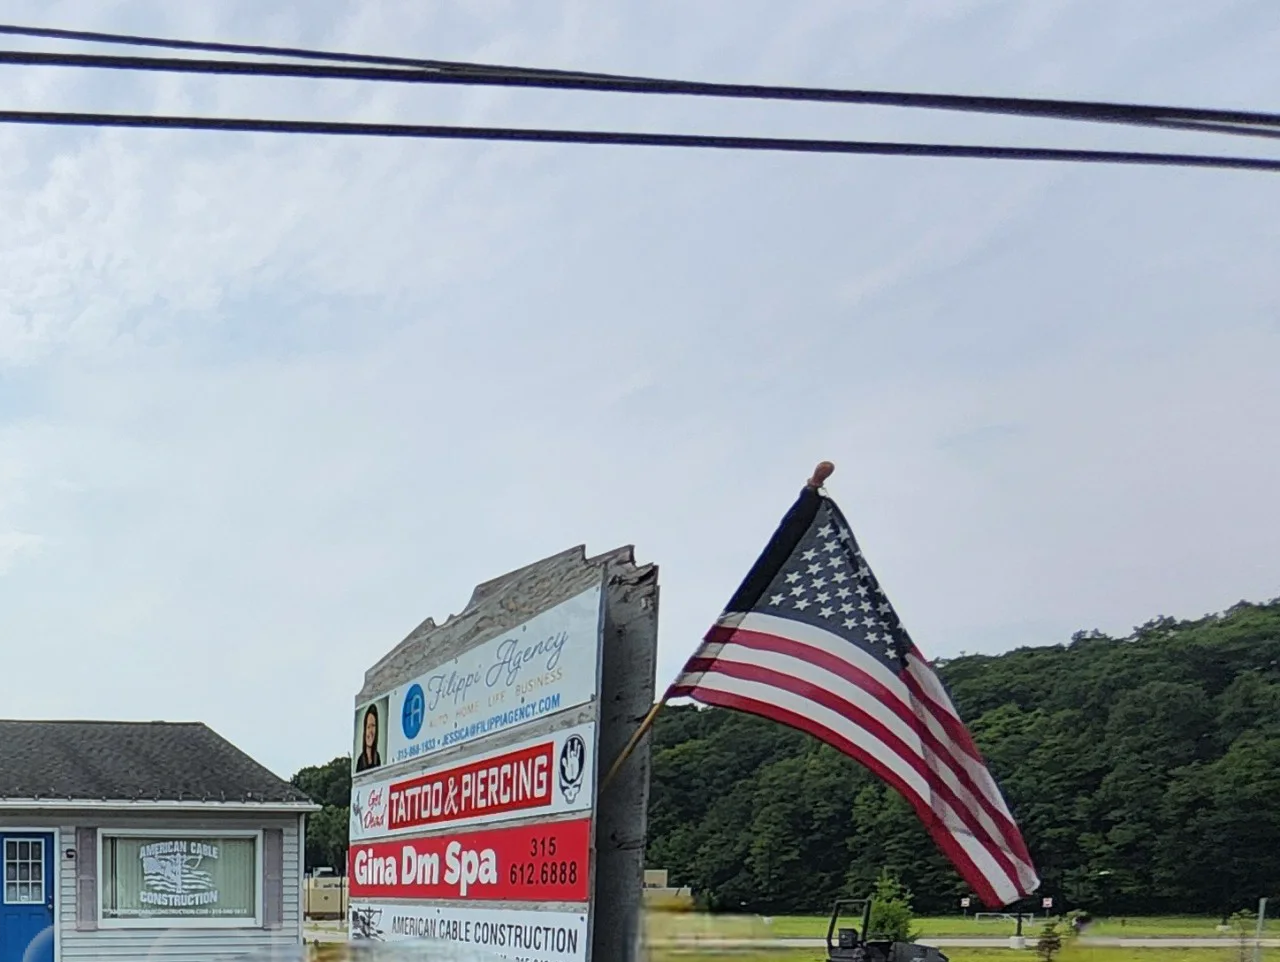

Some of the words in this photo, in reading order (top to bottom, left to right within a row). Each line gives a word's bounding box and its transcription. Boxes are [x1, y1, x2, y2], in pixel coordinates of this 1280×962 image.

[428, 665, 481, 711] Filippi
[486, 631, 568, 687] Agency
[487, 690, 505, 707] LIFE
[515, 667, 563, 696] BUSINESS
[442, 692, 561, 747] JESSICA@FILIPPIAGENCY.COM
[389, 780, 442, 824] TATTOO
[444, 776, 458, 816] &
[461, 754, 549, 812] PIERCING
[140, 840, 187, 859] AMERICAN
[190, 841, 219, 859] CABLE
[531, 836, 557, 857] 315
[354, 847, 397, 886] Gina
[401, 845, 440, 886] Dm
[444, 841, 498, 897] Spa
[509, 861, 578, 885] 612.6888
[140, 890, 218, 907] CONSTRUCTION
[391, 915, 437, 938] AMERICAN
[439, 918, 471, 942] CABLE
[474, 921, 578, 954] CONSTRUCTION
